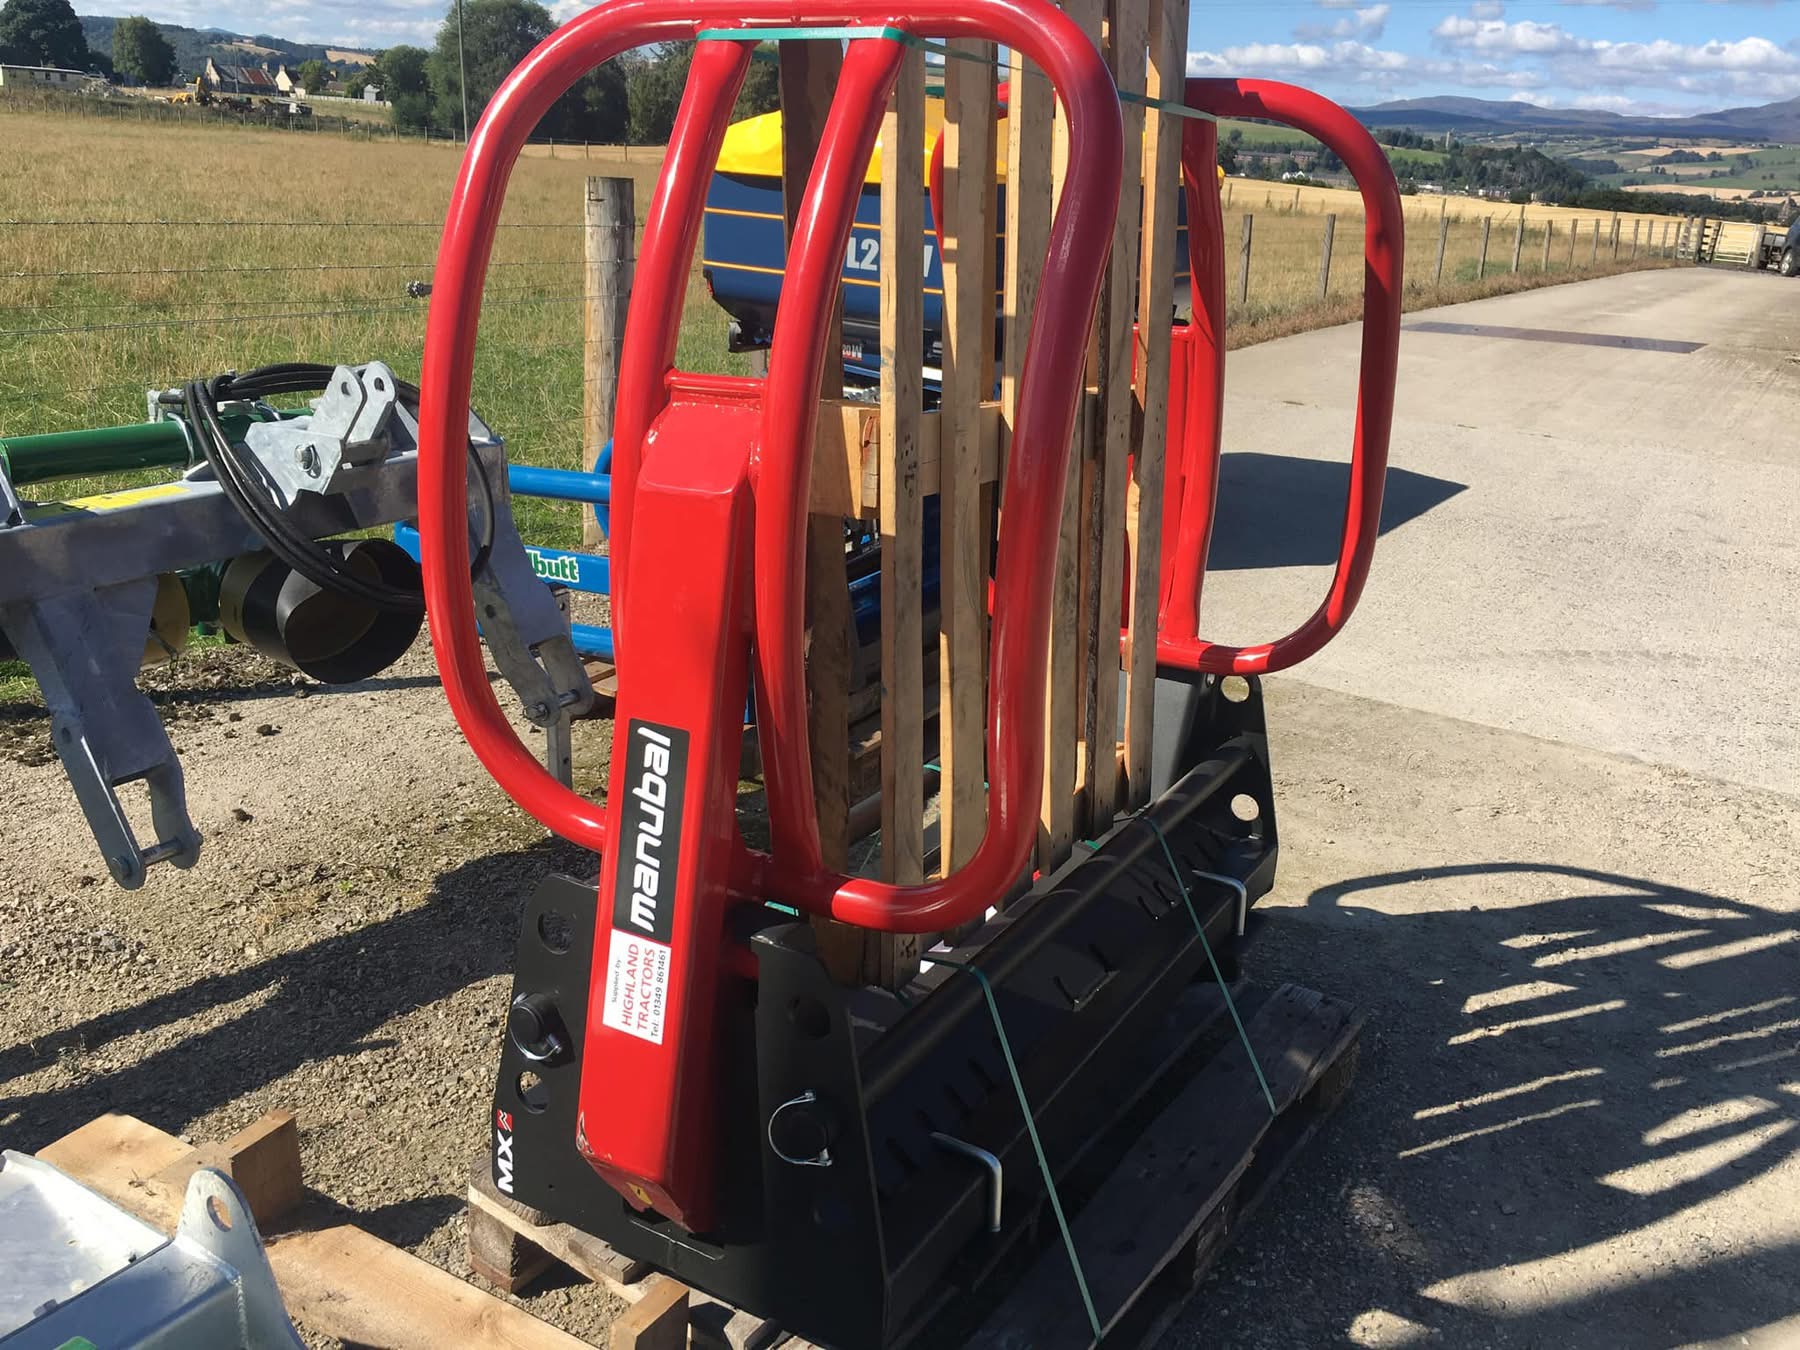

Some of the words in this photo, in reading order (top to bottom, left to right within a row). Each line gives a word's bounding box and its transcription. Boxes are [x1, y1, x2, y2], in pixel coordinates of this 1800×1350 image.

[630, 726, 671, 933] manubal
[612, 971, 621, 1003] Supplied
[621, 944, 639, 1027] HIGHLAND
[637, 948, 656, 1030] TRACTORS
[656, 950, 667, 984] 861461
[653, 987, 663, 1016] 01349
[497, 1129, 513, 1193] MX
